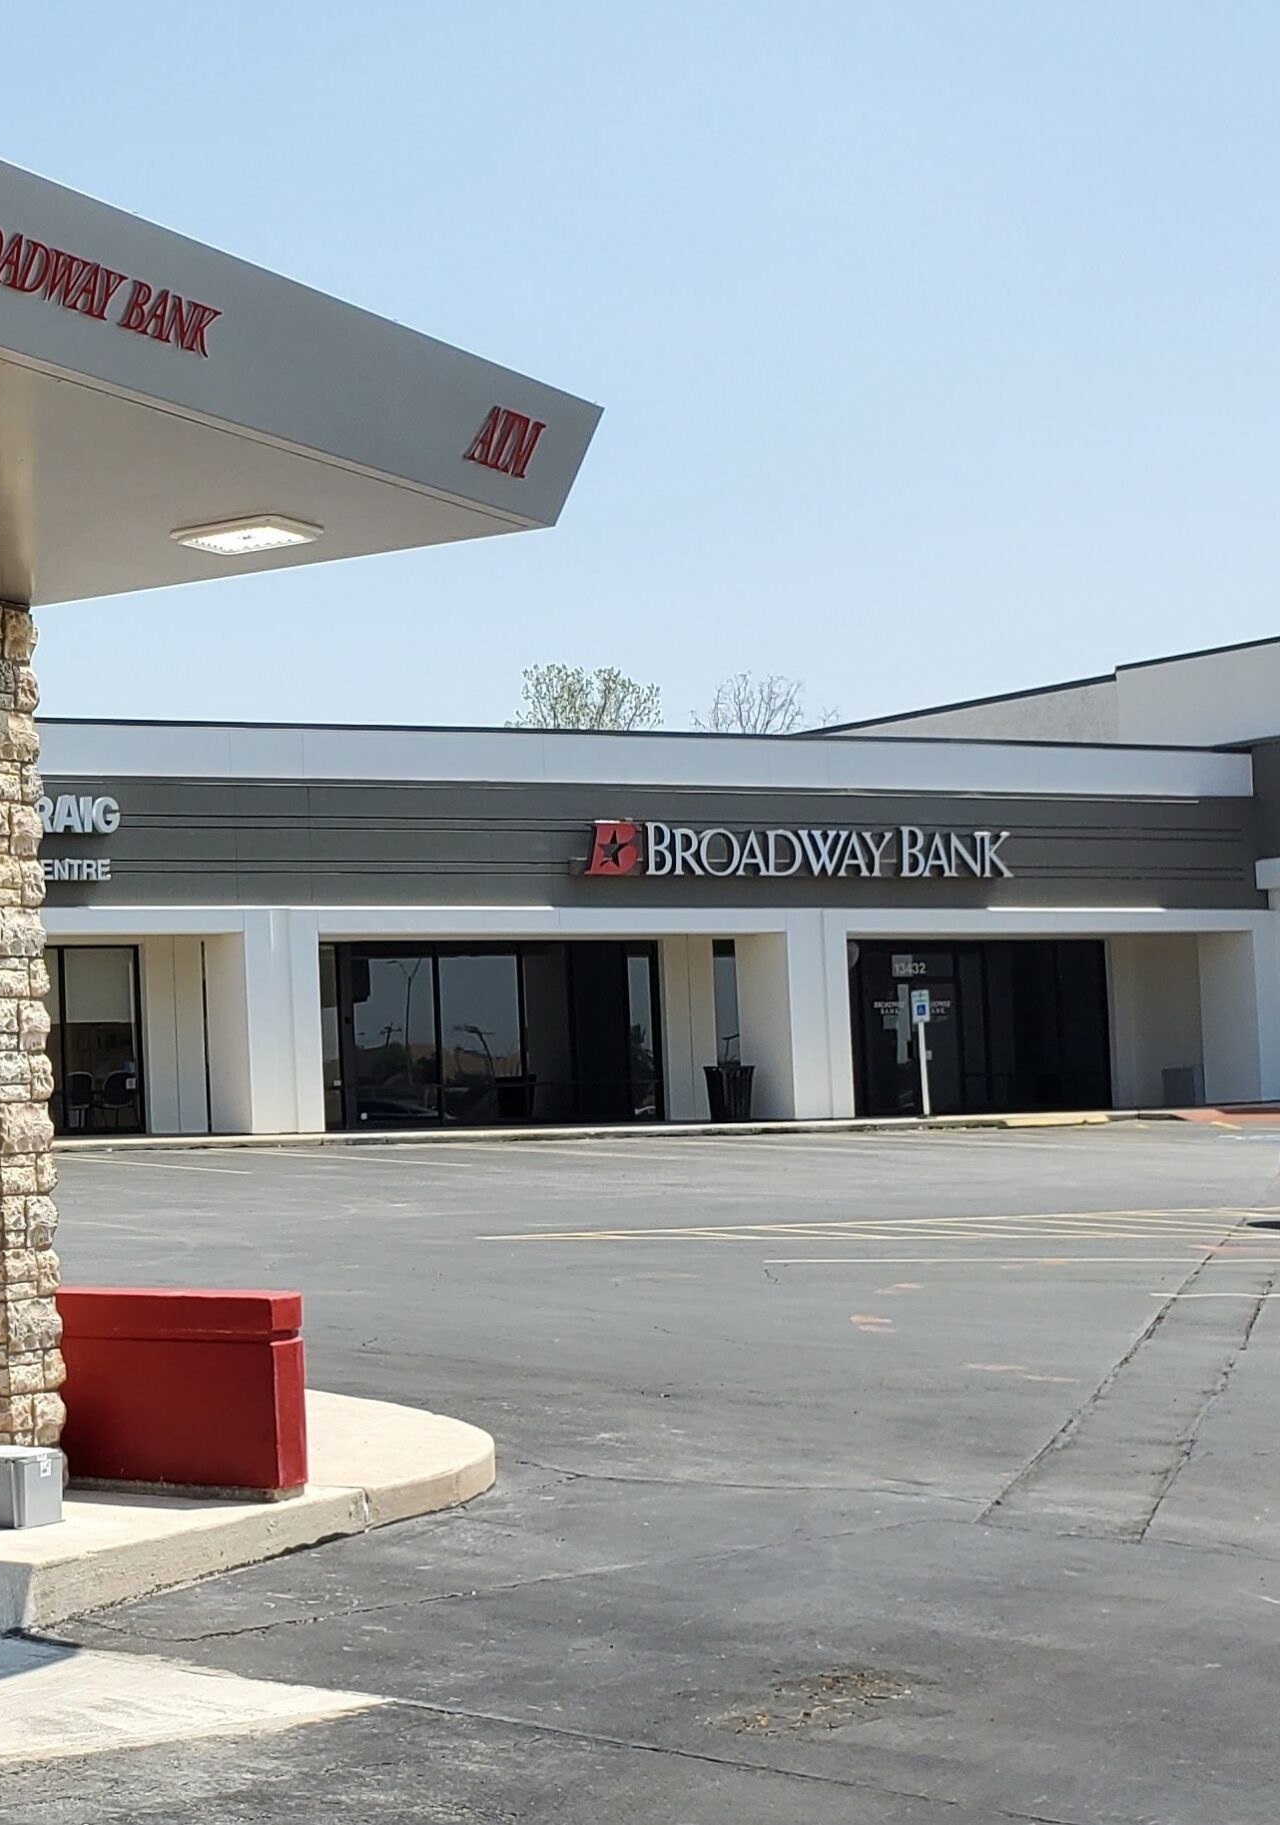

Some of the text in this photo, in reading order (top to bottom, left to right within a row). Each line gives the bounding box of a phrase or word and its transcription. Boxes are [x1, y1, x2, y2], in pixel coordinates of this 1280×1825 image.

[117, 278, 223, 359] BANK
[462, 404, 547, 479] ATM
[645, 820, 893, 878] BROADWAY
[900, 825, 1015, 879] BANK
[895, 962, 926, 974] 13432
